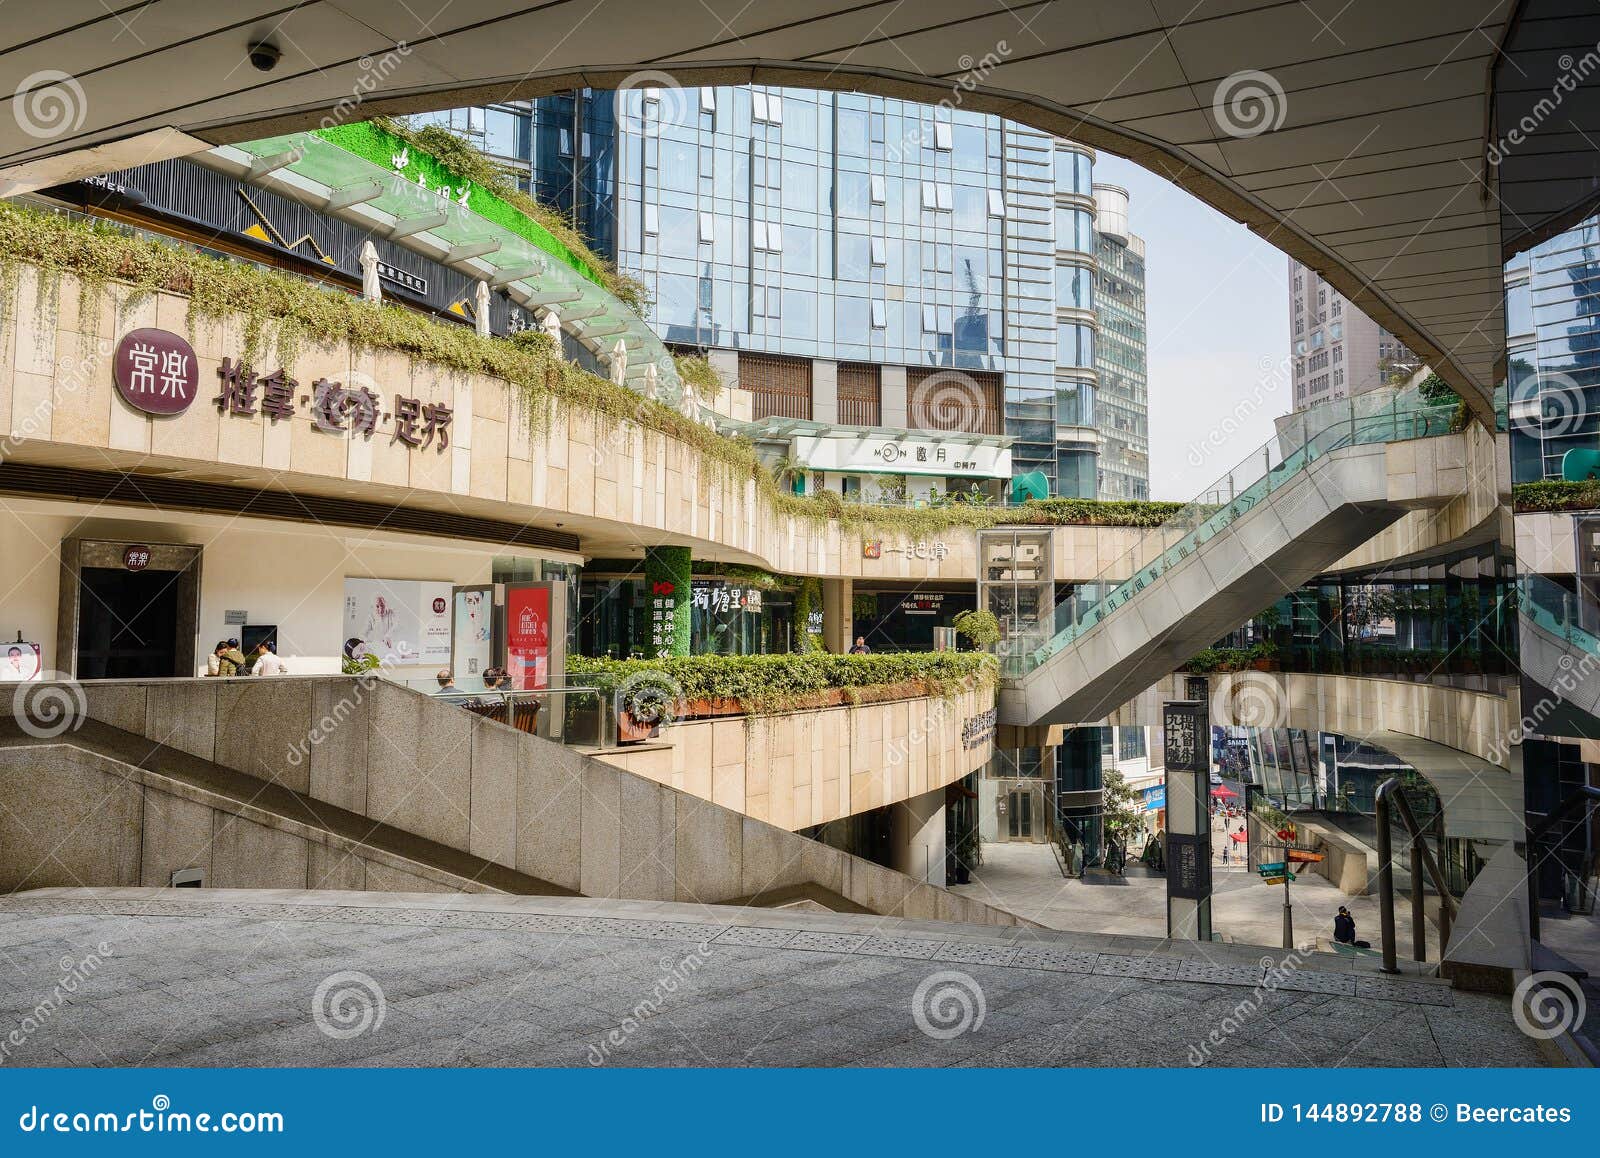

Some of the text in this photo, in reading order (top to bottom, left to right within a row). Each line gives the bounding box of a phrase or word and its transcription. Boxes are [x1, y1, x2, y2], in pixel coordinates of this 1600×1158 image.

[80, 176, 125, 193] RMER
[653, 599, 663, 645] 恒温泳池
[665, 599, 675, 645] 健身中心
